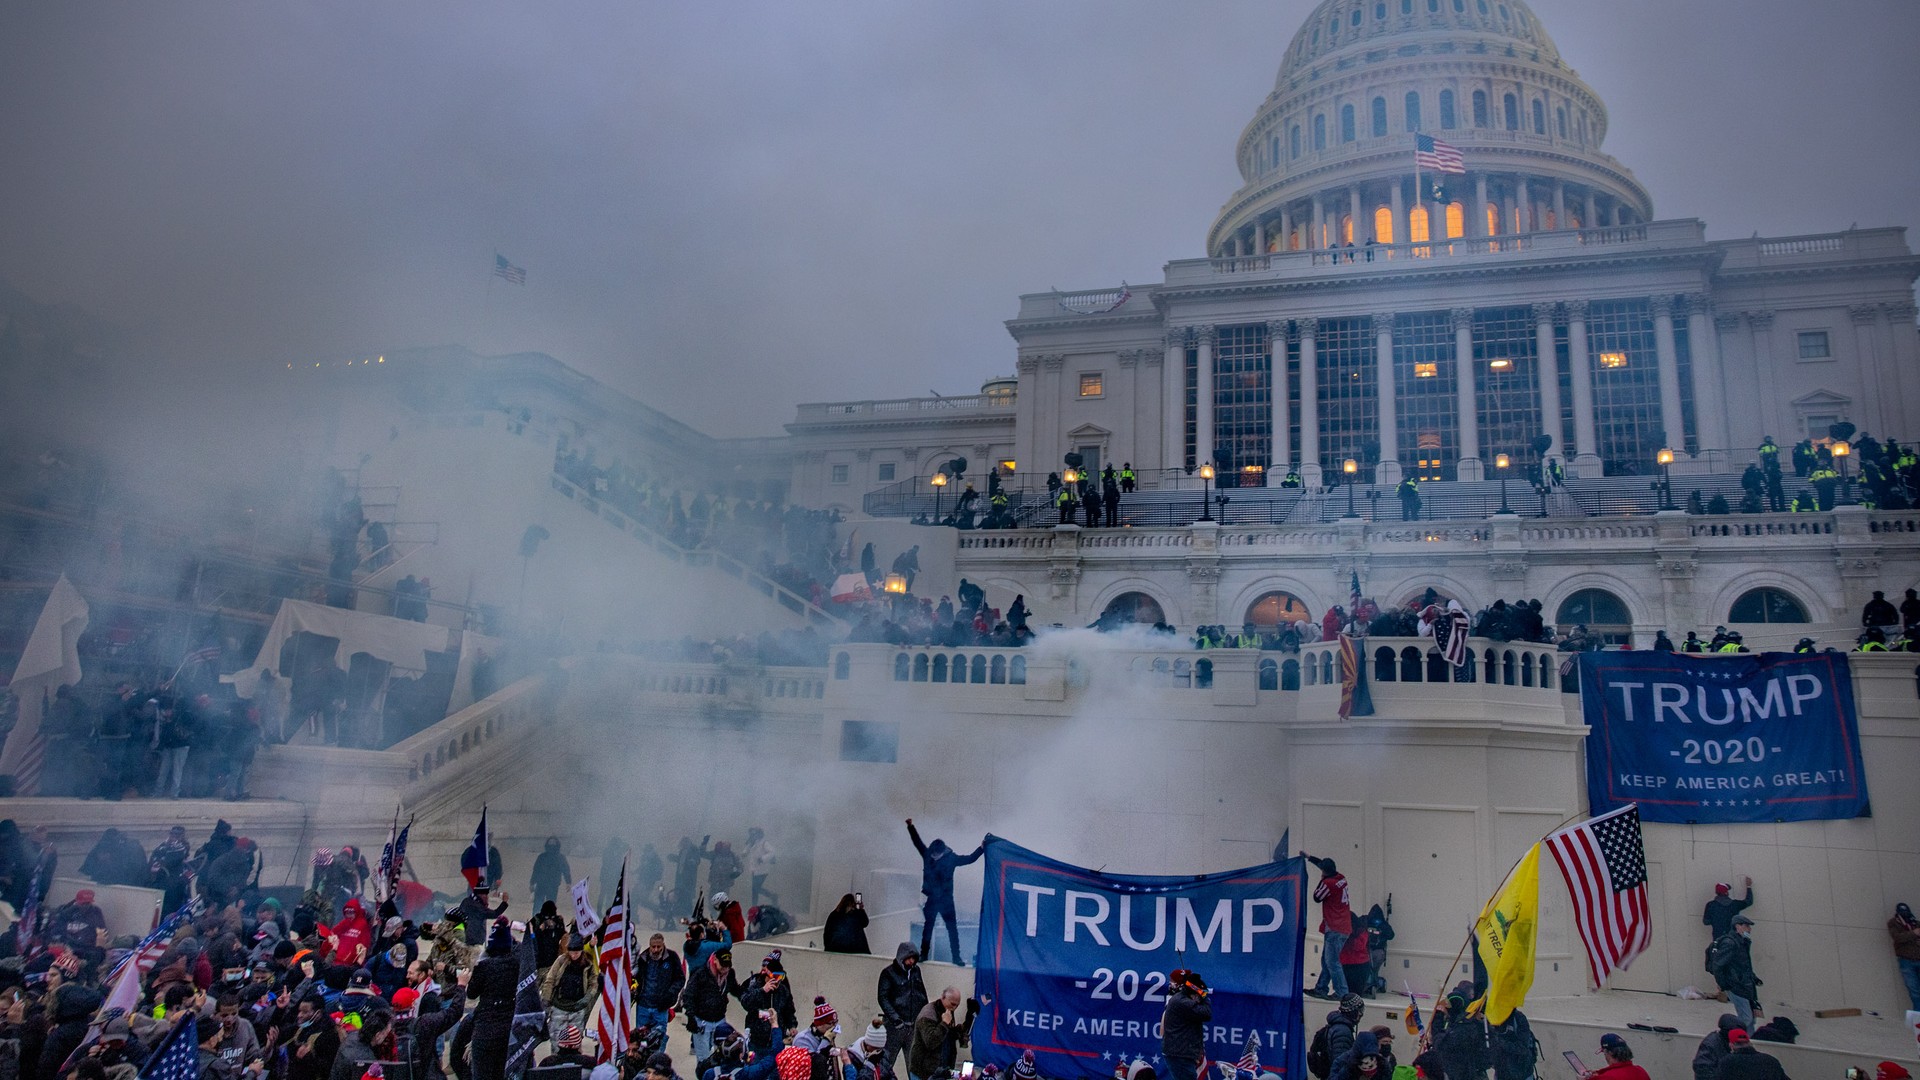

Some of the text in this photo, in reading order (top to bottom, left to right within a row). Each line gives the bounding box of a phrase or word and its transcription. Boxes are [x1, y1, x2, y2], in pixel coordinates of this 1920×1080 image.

[1609, 673, 1823, 725] TRUMP
[1670, 736, 1782, 765] -2020-
[1620, 769, 1846, 790] KEEP AMERICA GREAT!
[1012, 882, 1284, 954] TRUMP
[1006, 1008, 1064, 1031] KEEP
[1073, 1017, 1164, 1040] AMERIC
